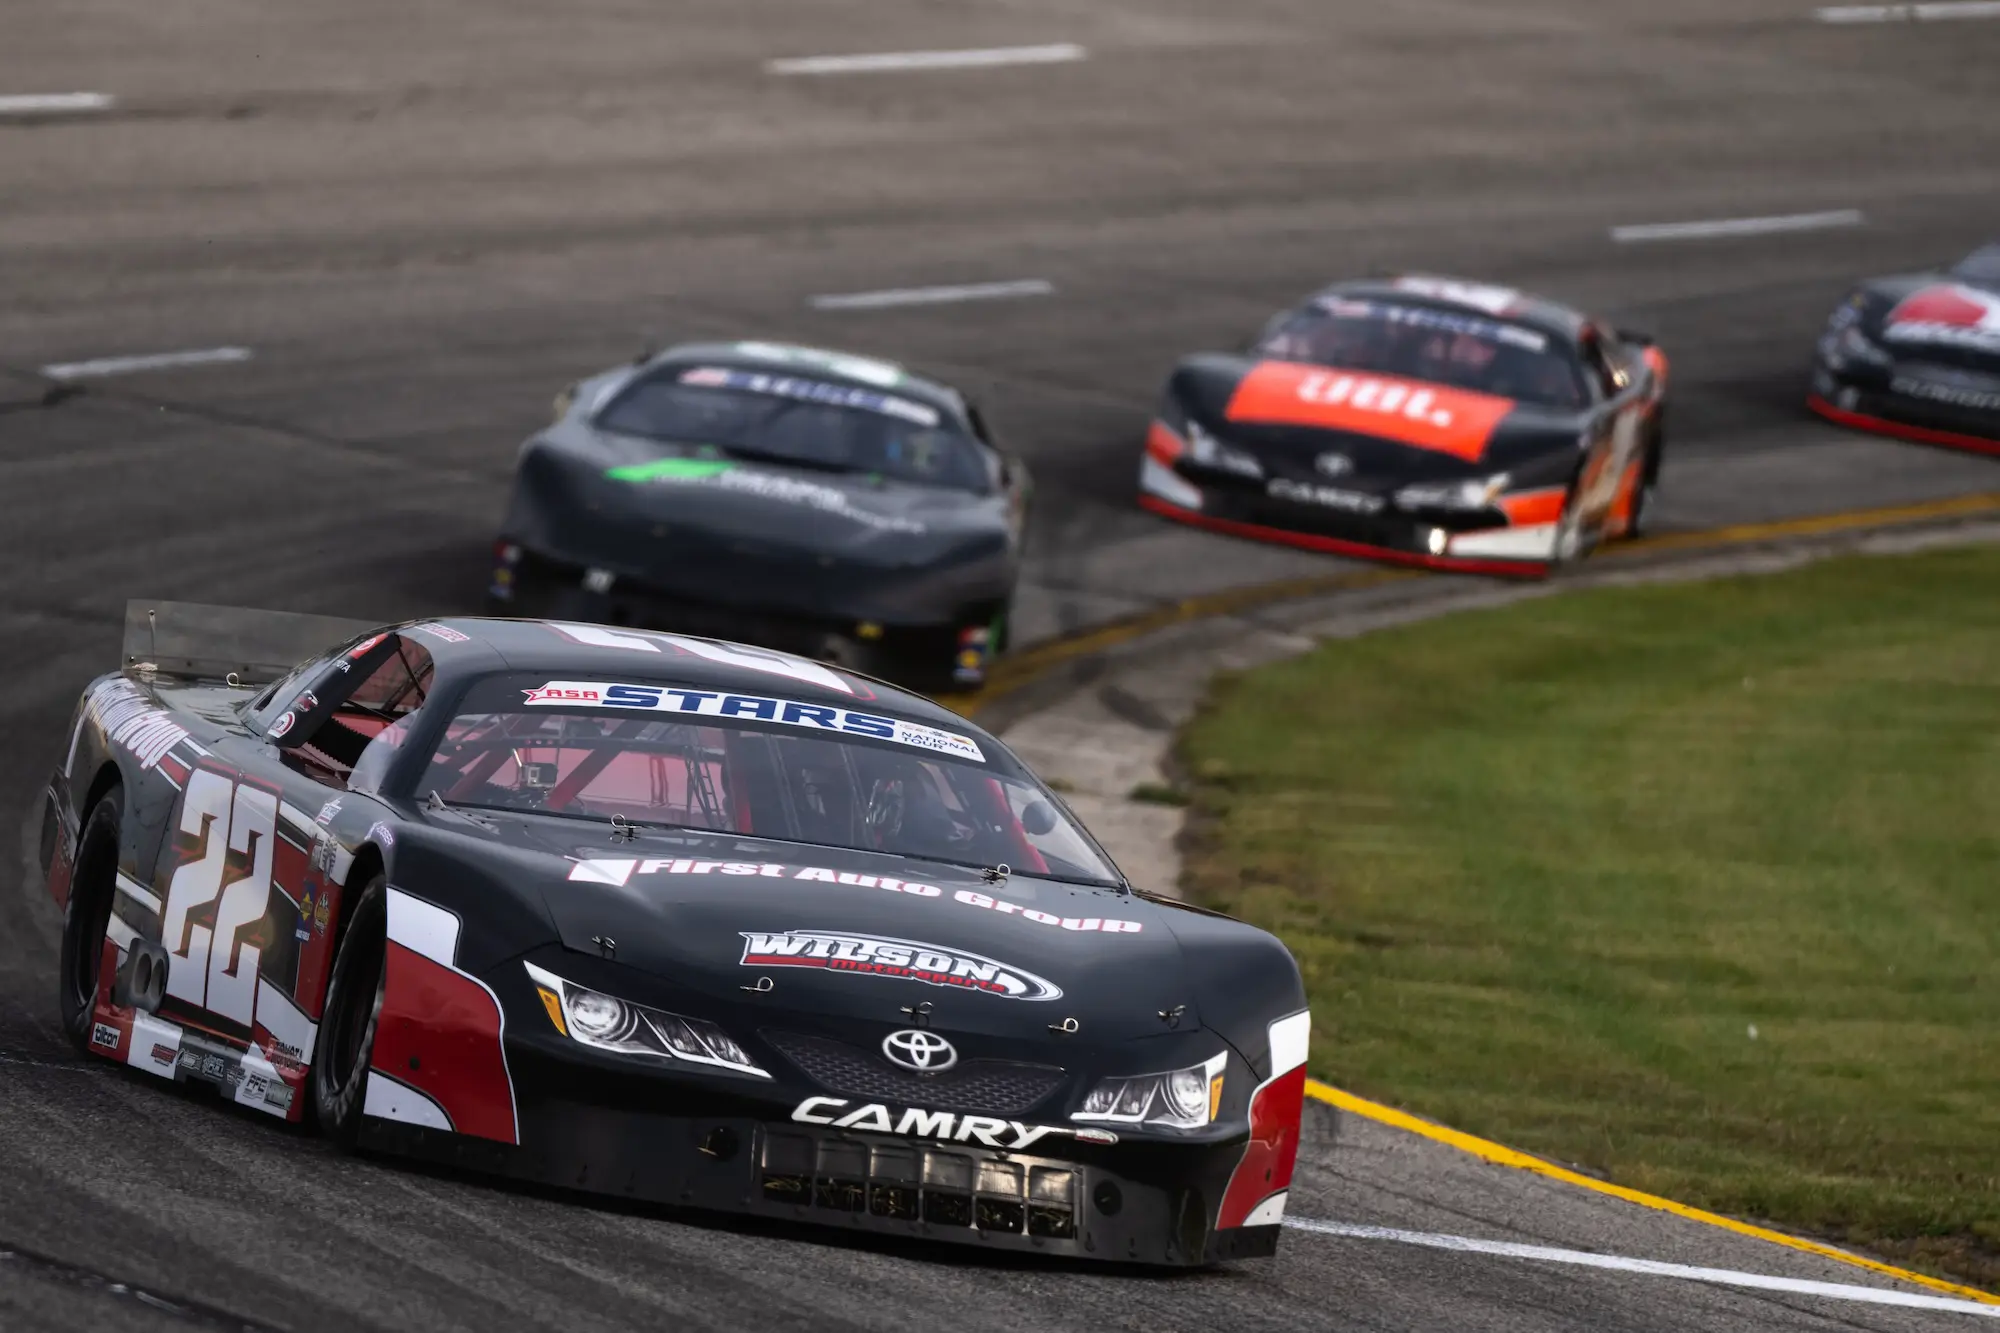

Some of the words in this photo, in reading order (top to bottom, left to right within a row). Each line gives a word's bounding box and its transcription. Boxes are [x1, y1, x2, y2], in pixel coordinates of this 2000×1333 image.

[546, 689, 599, 700] ASA
[602, 685, 898, 739] STARS
[902, 731, 979, 754] NATIONAL
[903, 737, 944, 750] TOUR
[162, 767, 279, 1028] 22
[638, 859, 786, 877] First
[793, 866, 943, 897] Auto
[953, 889, 1143, 933] Group
[750, 935, 1000, 982] WILSON
[95, 1024, 118, 1047] tilton
[791, 1096, 1062, 1149] CAMRY
